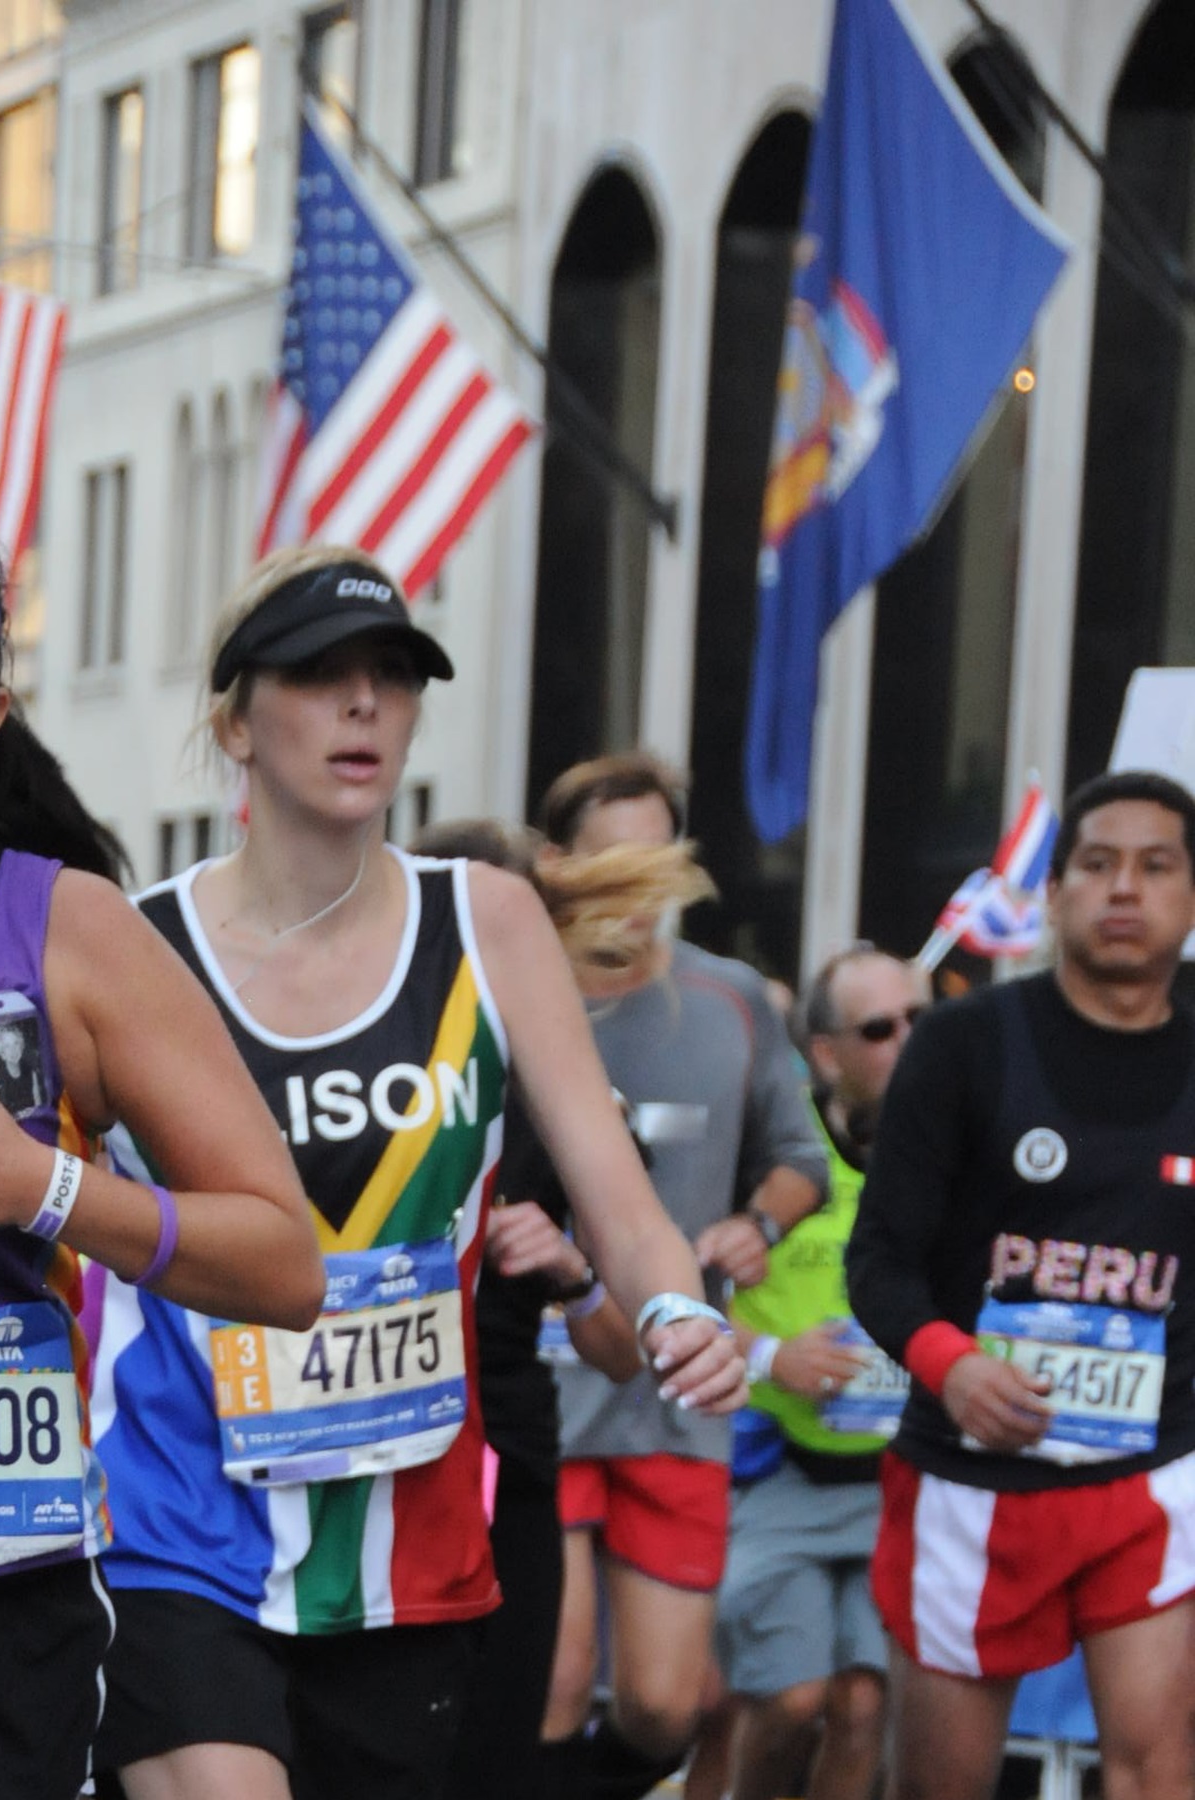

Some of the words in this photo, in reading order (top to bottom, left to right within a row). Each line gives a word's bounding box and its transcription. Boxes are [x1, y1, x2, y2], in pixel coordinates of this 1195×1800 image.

[280, 1057, 479, 1145] ISON
[989, 1232, 1178, 1311] PERU
[236, 1331, 257, 1367] 3
[300, 1308, 441, 1393] 47175
[1035, 1351, 1147, 1409] 54517
[242, 1374, 262, 1410] E
